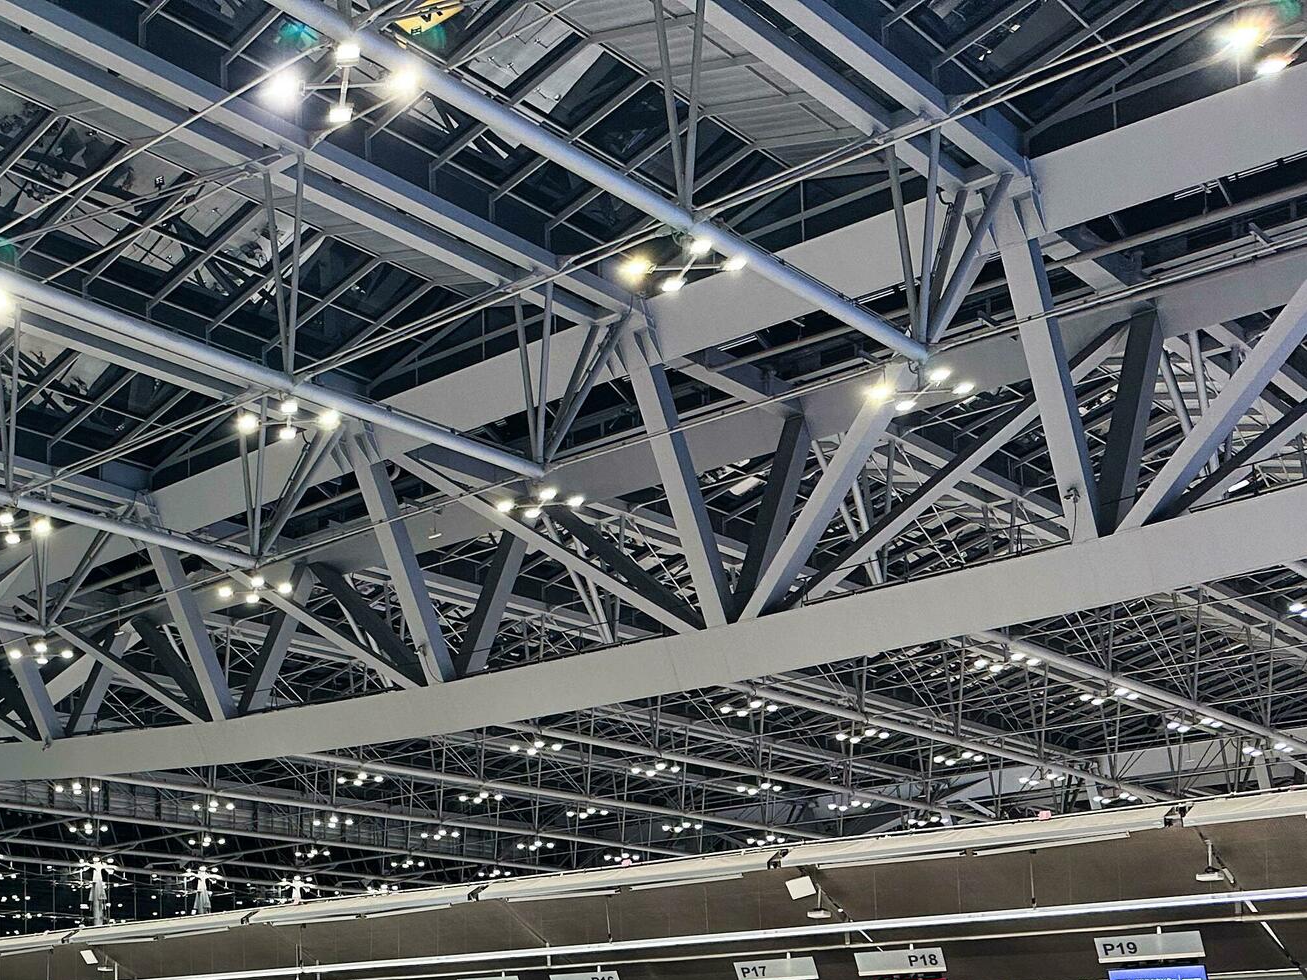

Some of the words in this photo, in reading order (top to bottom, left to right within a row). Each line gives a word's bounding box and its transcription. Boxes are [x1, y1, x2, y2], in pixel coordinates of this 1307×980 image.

[1102, 941, 1138, 956] P19
[907, 953, 939, 967] P18
[740, 965, 767, 978] P17
